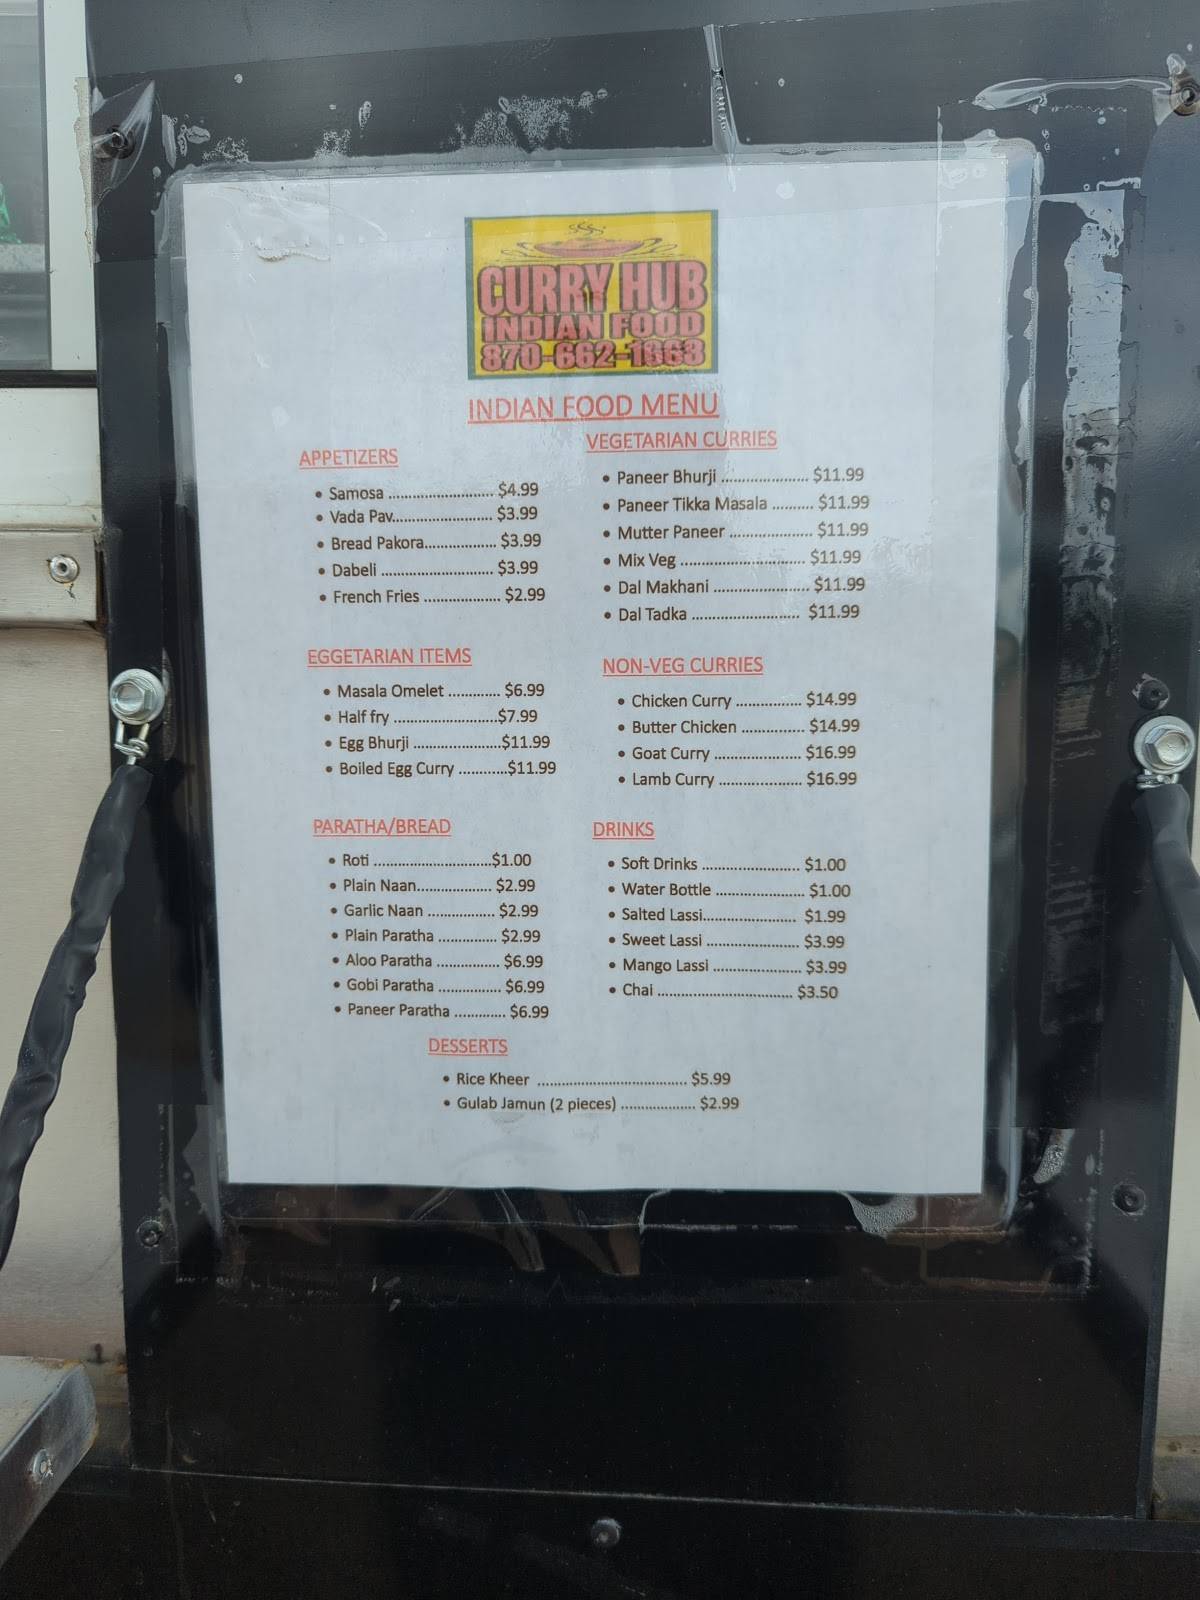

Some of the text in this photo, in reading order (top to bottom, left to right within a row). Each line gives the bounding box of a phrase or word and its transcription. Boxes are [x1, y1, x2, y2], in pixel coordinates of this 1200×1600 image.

[478, 260, 708, 316] CURRY HUB
[482, 311, 705, 342] INDIAN FOOD
[469, 393, 718, 420] INDIAN FOOD MENU
[586, 431, 777, 451] VEGETARIAN CURRIES
[299, 449, 398, 466] APPETIZERS
[617, 467, 864, 486] Paneer Bhurji $11.99
[329, 482, 539, 500] Samosa $4.99
[617, 494, 870, 512] Paneer Tikka Masala $11.99
[330, 511, 364, 524] Vada
[497, 505, 538, 521] $3.99
[618, 522, 869, 540] Mutter Paneer $11.99
[332, 537, 372, 550] Bread
[500, 532, 541, 548] $3.99
[618, 549, 861, 569] Mix Veg $11.99
[332, 560, 538, 577] Dabeli $3.99
[619, 576, 865, 594] Dal Makhani $11.99
[334, 588, 545, 603] French Fries $2.99
[619, 604, 859, 622] Dal Tadka $11.99
[308, 648, 472, 664] EGGETARIAN ITEMS
[603, 657, 763, 674] NON-VEG CURRIES
[338, 682, 544, 698] Masala Omelet $6.99
[632, 691, 856, 709] Chicken Curry $14.99
[339, 710, 367, 723] Half
[370, 710, 390, 726] fry
[633, 718, 860, 734] Butter Chicken $14.99
[339, 737, 364, 751] Egg
[369, 736, 409, 751] Bhurji
[632, 744, 856, 762] Goat Curry $16.99
[340, 762, 382, 775] Boiled
[388, 762, 412, 777] Egg
[416, 762, 454, 777] Curry
[633, 771, 857, 788] Lamb Curry $16.99
[313, 817, 451, 836] PARATHA/BREAD
[593, 822, 654, 837] DRINKS
[343, 853, 369, 867] Roti
[622, 857, 846, 872] Soft Drinks $1.00
[344, 879, 375, 892] Plain
[496, 878, 535, 894] $2.99
[622, 883, 851, 898] Water Bottle $1.00
[344, 903, 539, 919] Garlic Naan $2.99
[622, 908, 665, 921] Salted
[804, 909, 845, 924] $1.99
[346, 929, 541, 944] Plain Paratha $2.99
[622, 934, 845, 949] Sweet Lassi $3.99
[346, 954, 543, 969] Aloo Paratha $6.99
[623, 959, 847, 975] Mango Lassi $3.99
[347, 978, 545, 994] Gobi Paratha $6.99
[623, 983, 838, 1000] Chai $3.50
[348, 1003, 549, 1020] Paneer Paratha $6.99
[429, 1038, 508, 1054] DESSERTS
[456, 1070, 731, 1086] Rice Kheer $5.99
[457, 1096, 739, 1113] Gulab Jamun (2 pieces) $2.99
